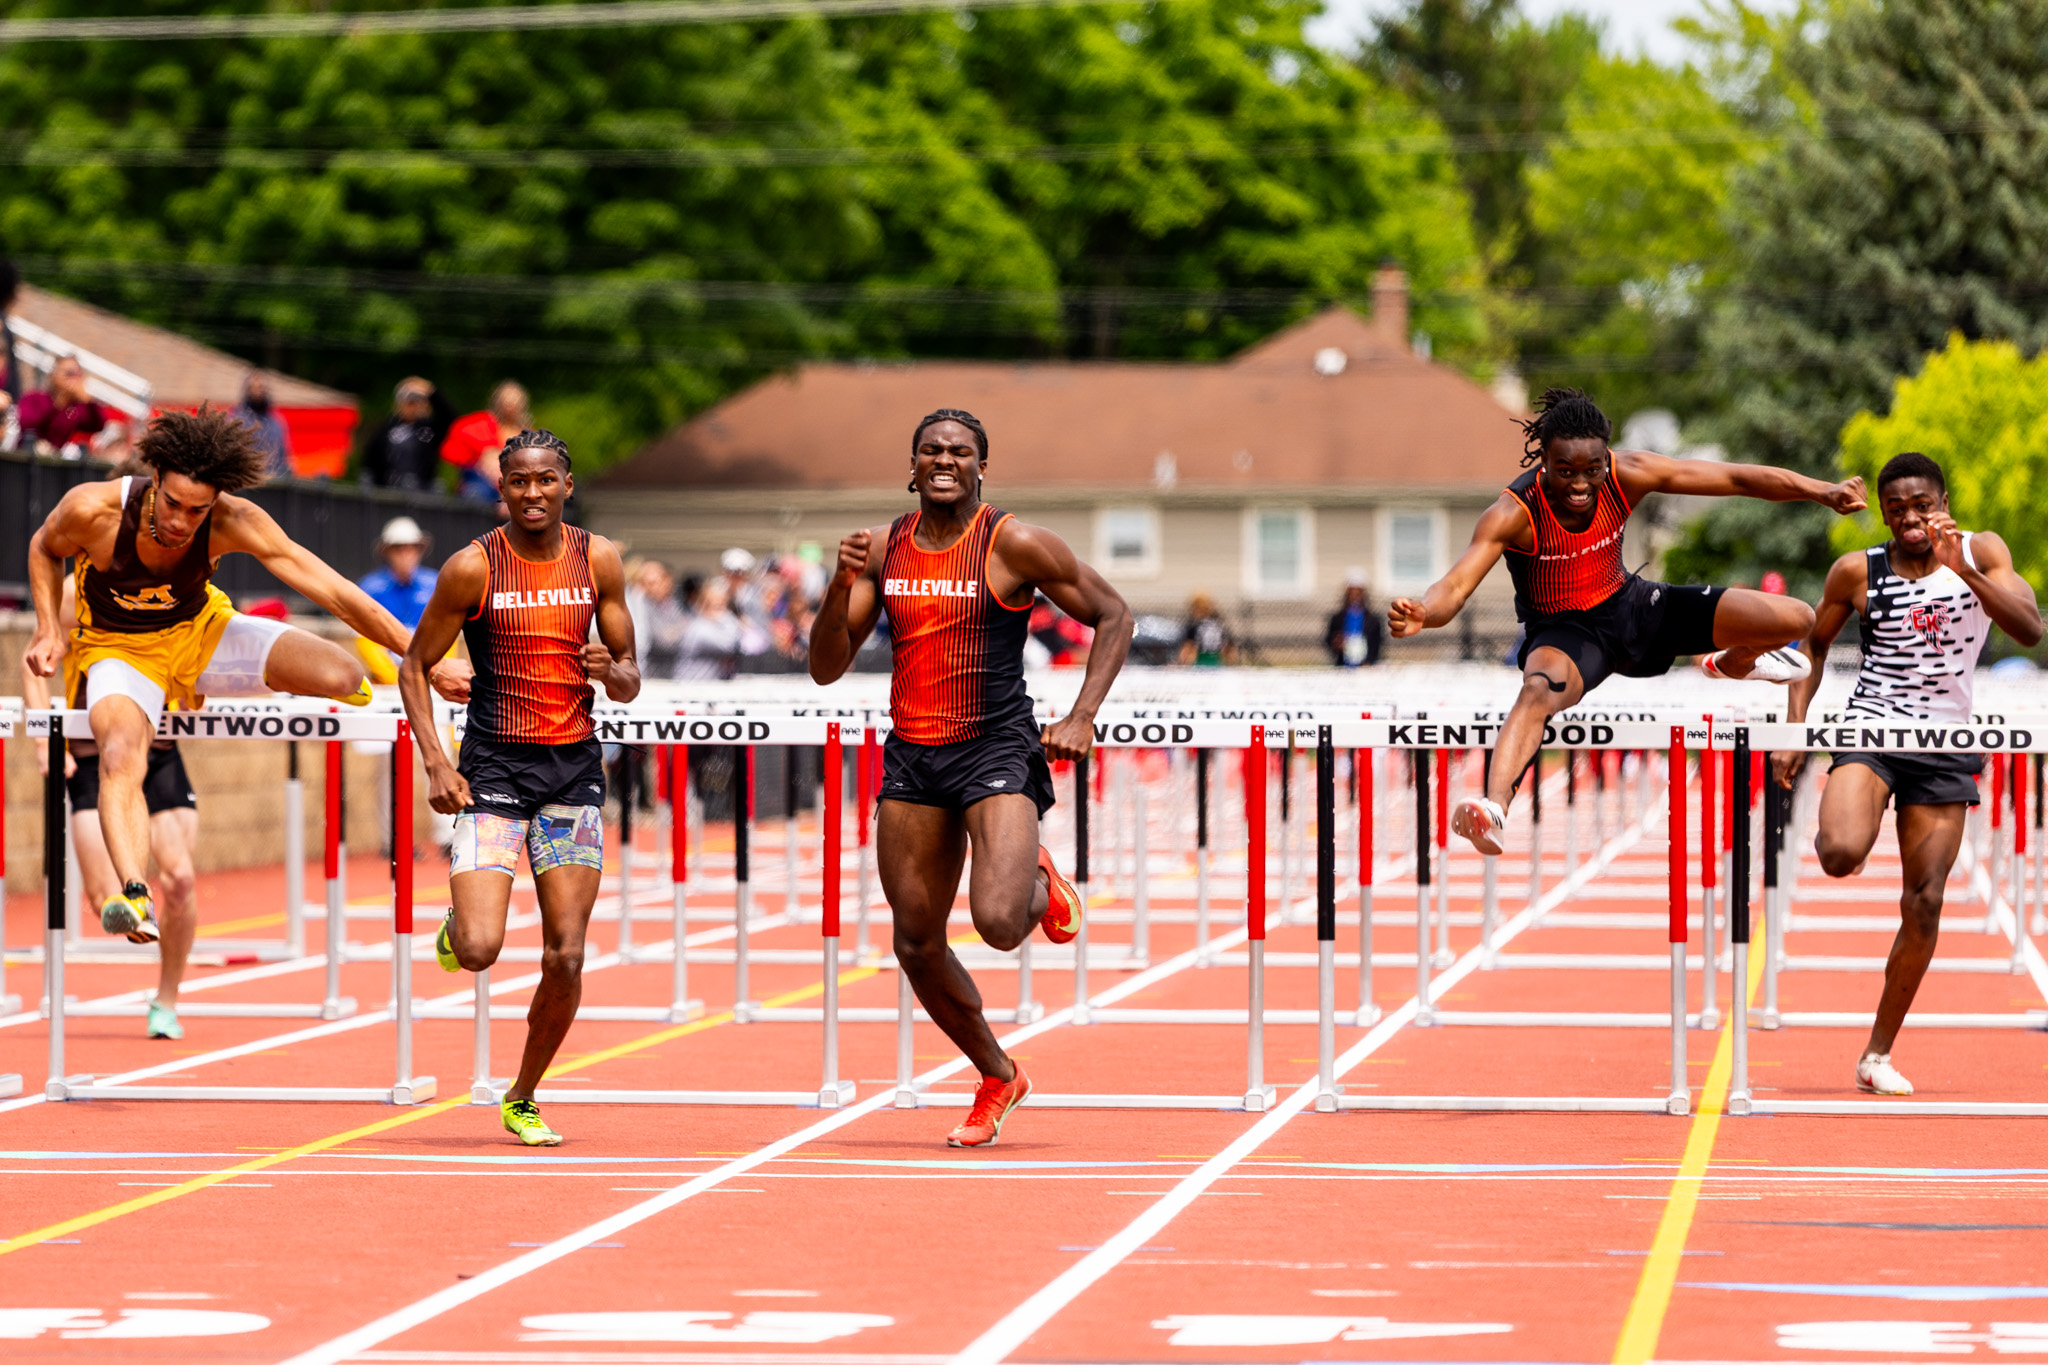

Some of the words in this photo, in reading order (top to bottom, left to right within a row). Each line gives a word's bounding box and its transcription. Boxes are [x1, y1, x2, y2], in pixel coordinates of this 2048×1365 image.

[492, 587, 593, 610] BELLEVILLE
[884, 578, 978, 598] BELLEVILLE
[157, 715, 341, 737] NTWOOD
[601, 720, 771, 741] NTWOOD
[1388, 724, 1614, 745] KENTOOD
[1806, 727, 2033, 749] KENTWOOD
